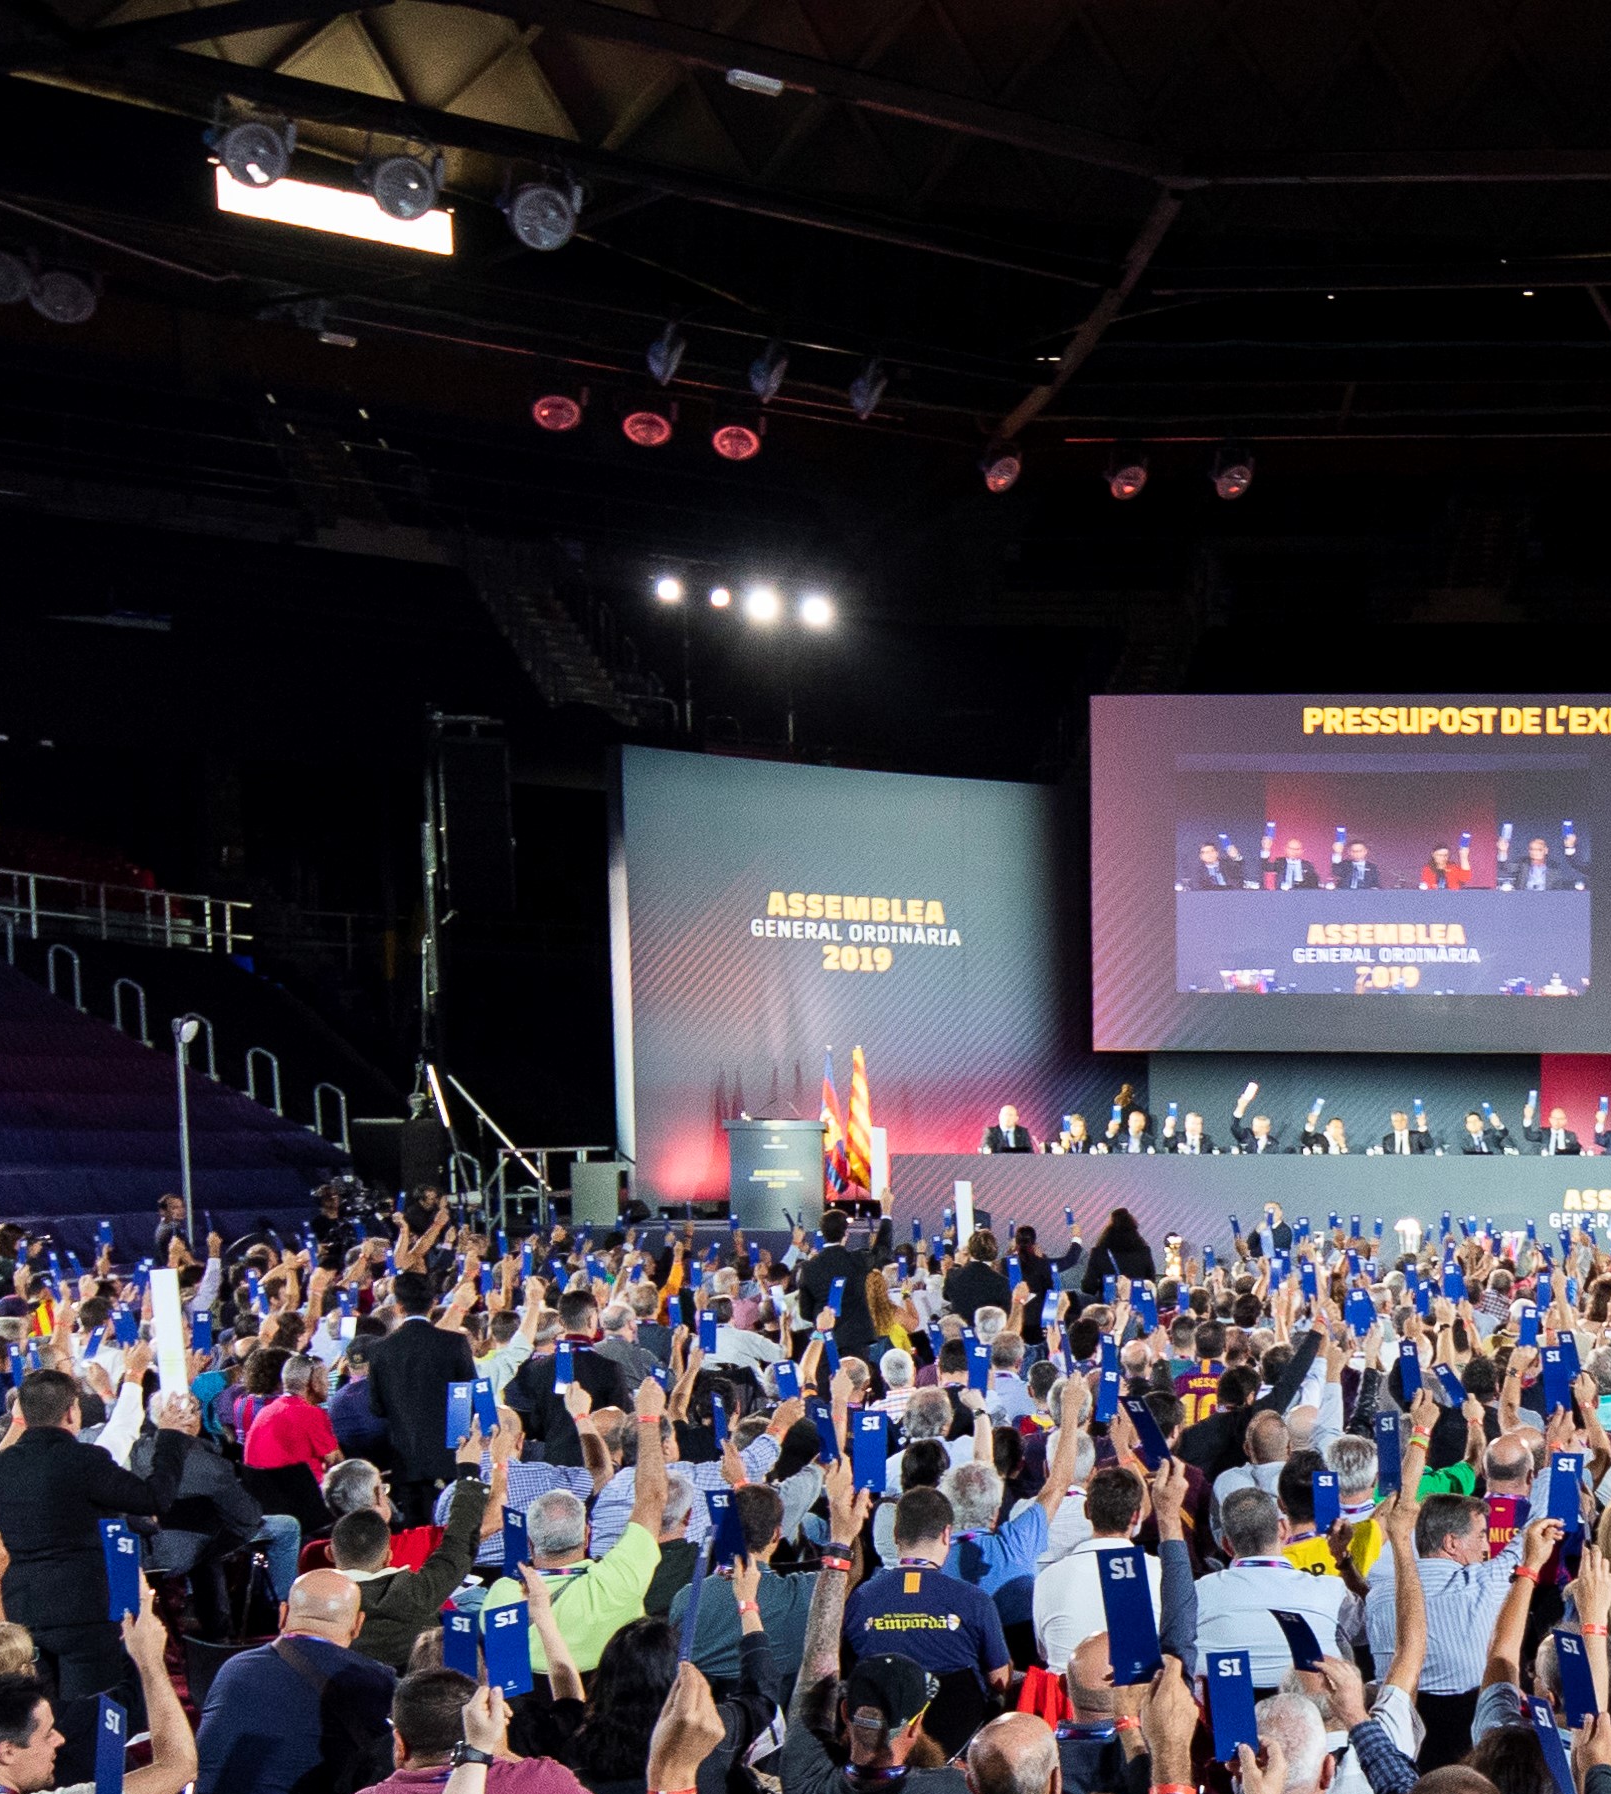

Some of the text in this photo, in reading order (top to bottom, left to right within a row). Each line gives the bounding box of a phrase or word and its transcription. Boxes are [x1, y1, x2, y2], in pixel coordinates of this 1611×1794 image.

[1302, 705, 1496, 735] PRESSUPOST
[1501, 705, 1541, 734] DE
[767, 891, 945, 926] ASSEMBLEA
[750, 918, 962, 947] GENERAL ORDINÀRIA
[1306, 923, 1466, 945] ASSEMBLEA
[821, 944, 893, 973] 2019
[1292, 945, 1481, 964] GENERAL ORDINÀRIA
[1355, 964, 1420, 987] 2019
[454, 1386, 470, 1401] SI
[862, 1416, 880, 1431] SI
[1558, 1458, 1576, 1472] SI
[712, 1495, 729, 1507] SI
[508, 1513, 522, 1527] SI
[117, 1537, 134, 1554] SI
[1109, 1557, 1136, 1579] SI
[452, 1616, 471, 1632] SI
[494, 1609, 518, 1628] SI
[1561, 1637, 1580, 1655] SI
[1218, 1658, 1242, 1677] SI
[105, 1709, 120, 1734] SI
[1535, 1706, 1552, 1728] SI
